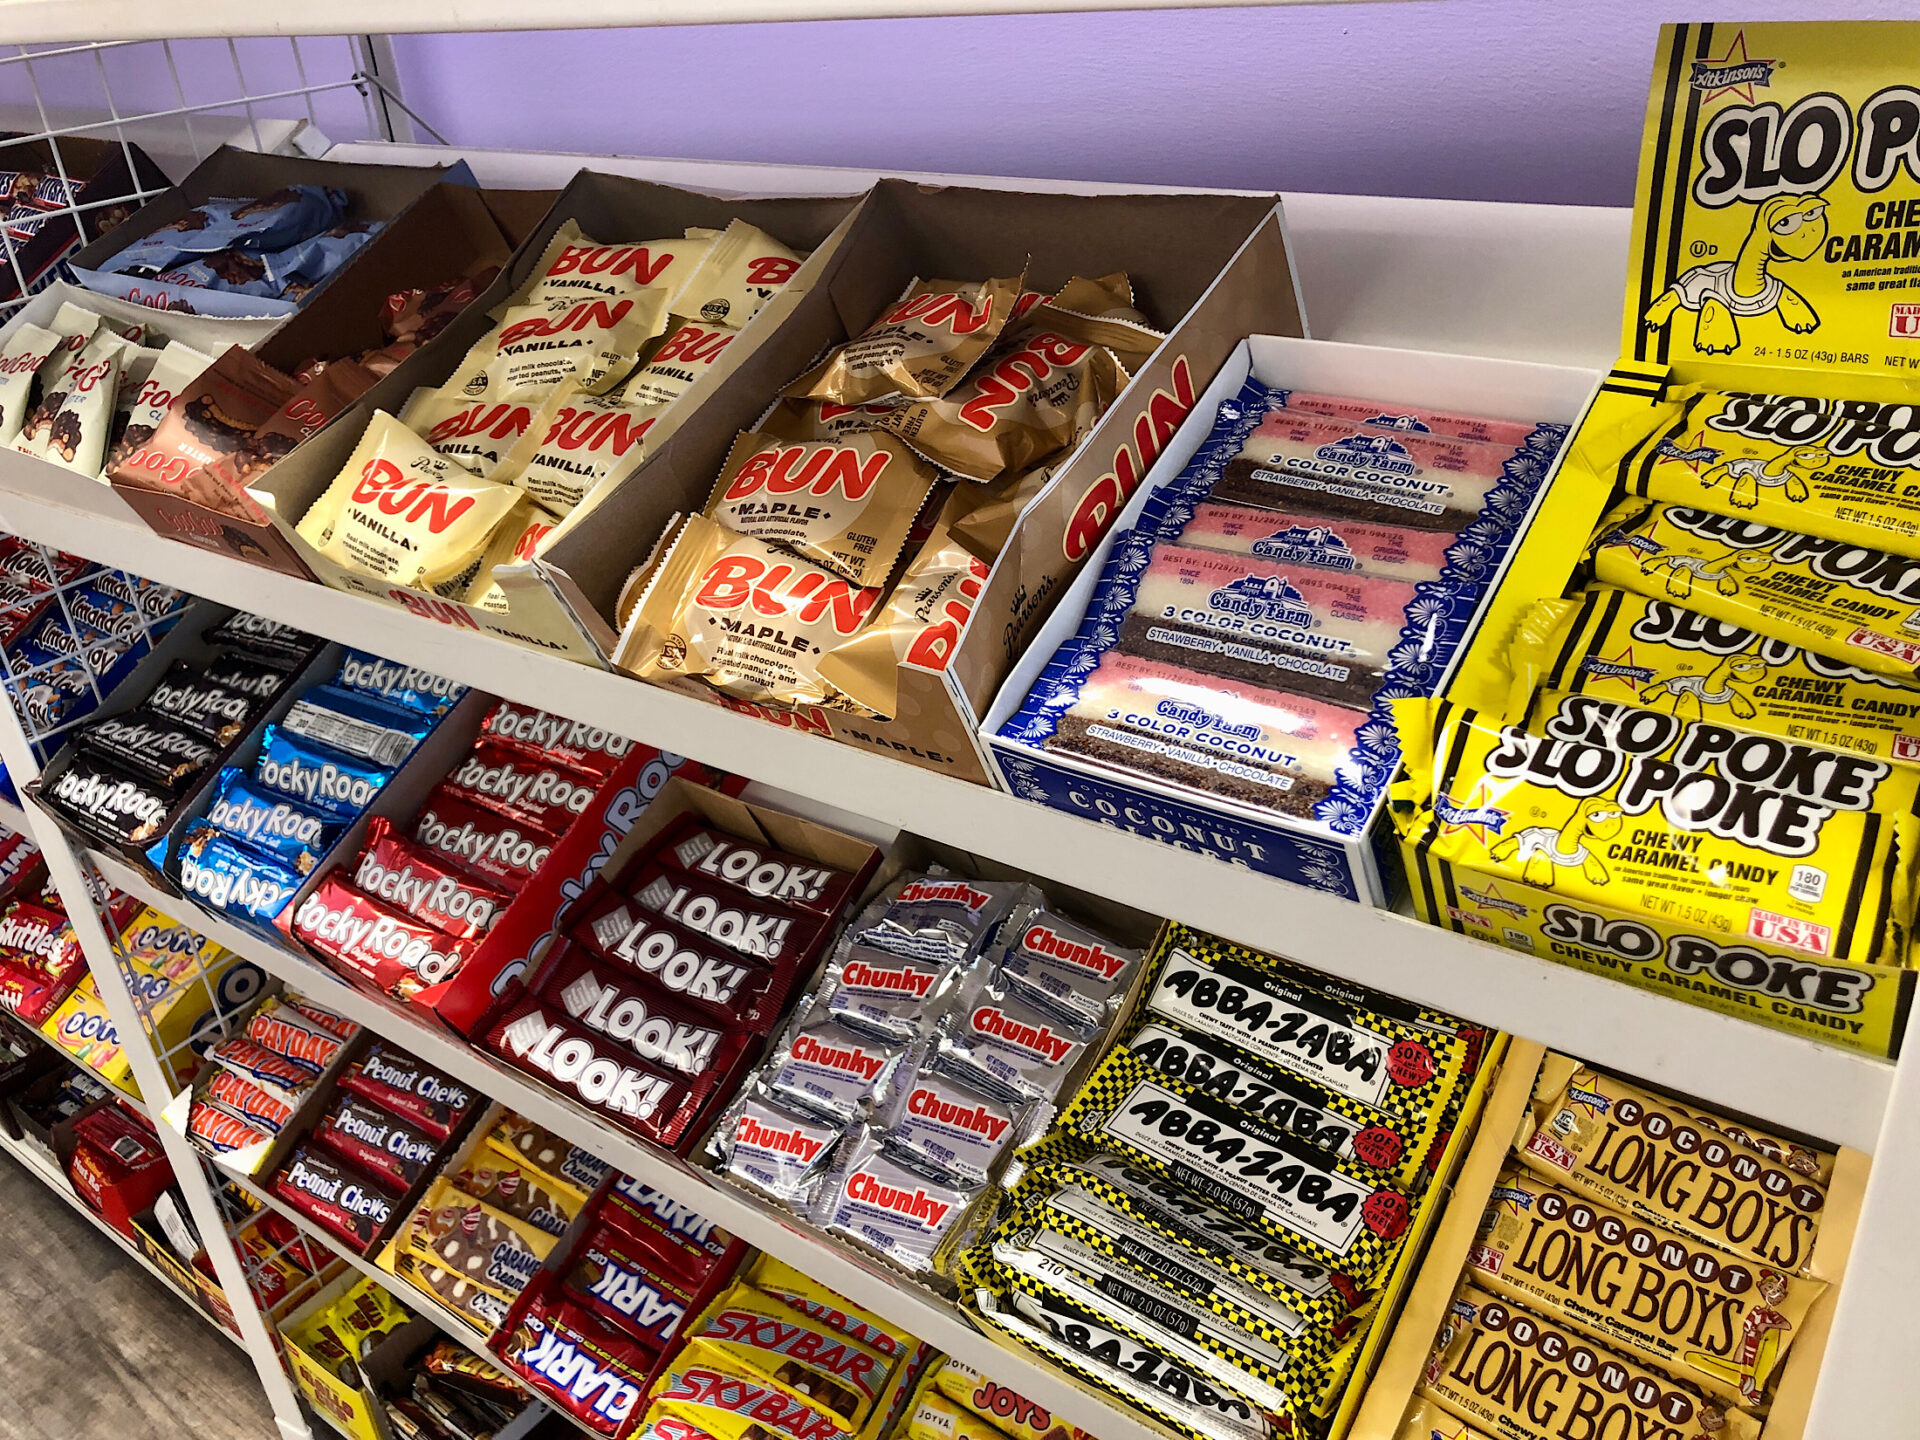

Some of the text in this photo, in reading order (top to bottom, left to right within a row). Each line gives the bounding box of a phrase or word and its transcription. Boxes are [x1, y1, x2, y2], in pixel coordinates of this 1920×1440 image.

[1696, 64, 1767, 88] Atkinson's
[1697, 97, 1848, 204] SLO
[547, 245, 674, 285] BUN
[550, 280, 616, 296] VANILLA
[1846, 280, 1906, 292] same great
[1854, 267, 1891, 278] American
[498, 300, 633, 349] BUN
[504, 339, 584, 356] VANILLA
[1754, 347, 1905, 367] 24 1.5 OZ (43g) BARS NET
[958, 332, 1097, 432] BUN
[428, 403, 532, 442] BUN
[540, 407, 655, 456] BUN
[724, 446, 893, 501] BUN
[1270, 455, 1448, 495] 3 COLOR COCONUT
[1317, 447, 1415, 475] Candy Farm
[1810, 471, 1897, 494] CARAMEL
[1834, 464, 1904, 481] CHEWY
[352, 459, 475, 533] BUN
[738, 503, 821, 520] MAPLE
[1253, 471, 1443, 514] STRAWBERRY VANILLA CHOCOLATE
[352, 510, 410, 551] VANILLA
[847, 531, 878, 546] GLUTEN
[854, 541, 874, 554] FREE
[1252, 541, 1353, 569] Candy Farm
[695, 554, 884, 636] BUN
[1209, 590, 1310, 625] Candy Farm
[1331, 610, 1364, 622] CLASSIC
[389, 589, 560, 650] BUN VANILLA
[722, 617, 810, 653] MAPLE
[1164, 606, 1350, 652] 3 COLOR COCONUT
[1149, 629, 1347, 679] STRAWBERRY VANILLA CHOCOLATE
[1853, 634, 1913, 661] USA
[1753, 686, 1919, 719] CARAMEL CANDY
[1776, 675, 1846, 694] CHEWY
[1156, 700, 1208, 727] Candy
[852, 729, 941, 762] MAPLE
[1089, 725, 1291, 787] STRAWBERRY VANILLA CHOCOLATE
[1126, 713, 1296, 766] COLOR COCONUT
[1787, 725, 1878, 756] NET WT 1.5 OZ (43g)
[1680, 724, 1888, 806] POKE
[1486, 728, 1837, 856] SLO POKE
[1068, 791, 1266, 861] COCONUT
[1632, 829, 1703, 852] CHEWY
[698, 843, 834, 901] LOOK!
[1607, 846, 1779, 886] CARAMEL CANDY
[1795, 869, 1822, 889] 180
[900, 883, 991, 910] Chunky
[1622, 875, 1760, 904] same great flavor longer chew
[663, 887, 795, 958] LOOK!
[1753, 910, 1827, 935] MADE THE
[1754, 919, 1825, 954] USA
[616, 920, 751, 1003] LOOK!
[1023, 925, 1128, 979] Chunky
[1542, 905, 1662, 960] SLO
[1668, 937, 1873, 1012] POKE
[842, 961, 938, 998] Chunky
[1263, 980, 1303, 1002] Original
[1325, 984, 1365, 1004] Original
[1551, 941, 1636, 973] CHEWY
[1641, 966, 1763, 1010] CARAMEL
[1772, 1000, 1865, 1035] CANDY
[250, 1012, 338, 1066] PAYDAY
[586, 985, 723, 1074] LOOK!
[972, 1007, 1072, 1064] Chunky
[1163, 968, 1383, 1083] ABBA-ZABA
[529, 1026, 674, 1120] LOOK!
[791, 1034, 887, 1080] Chunky
[1233, 1057, 1274, 1081] Original
[209, 1070, 293, 1125] PAYDAY
[363, 1056, 468, 1109] Peanut Chews
[1134, 1037, 1351, 1153] ABBA-ZABA
[334, 1109, 434, 1163] Peanut Chews
[738, 1117, 823, 1162] Chunky
[908, 1090, 1009, 1143] Chunky
[1239, 1120, 1281, 1143] Original
[1129, 1099, 1358, 1224] ABBA-ZABA
[1364, 1131, 1399, 1154] SOFT
[1527, 1138, 1572, 1169] USA
[1619, 1103, 1820, 1210] COCONUT
[286, 1162, 391, 1223] Peanut Chews
[847, 1173, 951, 1229] Chunky
[1203, 1157, 1219, 1169] WITH
[1270, 1190, 1293, 1207] CENTER
[1584, 1124, 1813, 1270] LONG BOYS
[1037, 1258, 1064, 1277] 210
[1541, 1196, 1751, 1294] COCONUT
[1106, 1281, 1190, 1333] NET WT. 2.0 OZ (57g)
[1513, 1219, 1744, 1357] LONG BOYS
[1564, 1298, 1678, 1353] Chewy Caramel Bar
[521, 1329, 640, 1422] CLARK
[1450, 1328, 1568, 1417] LONG
[1483, 1305, 1690, 1422] COCONUT
[918, 1410, 949, 1431] JOYVA
[972, 1381, 1051, 1431] JOYS
